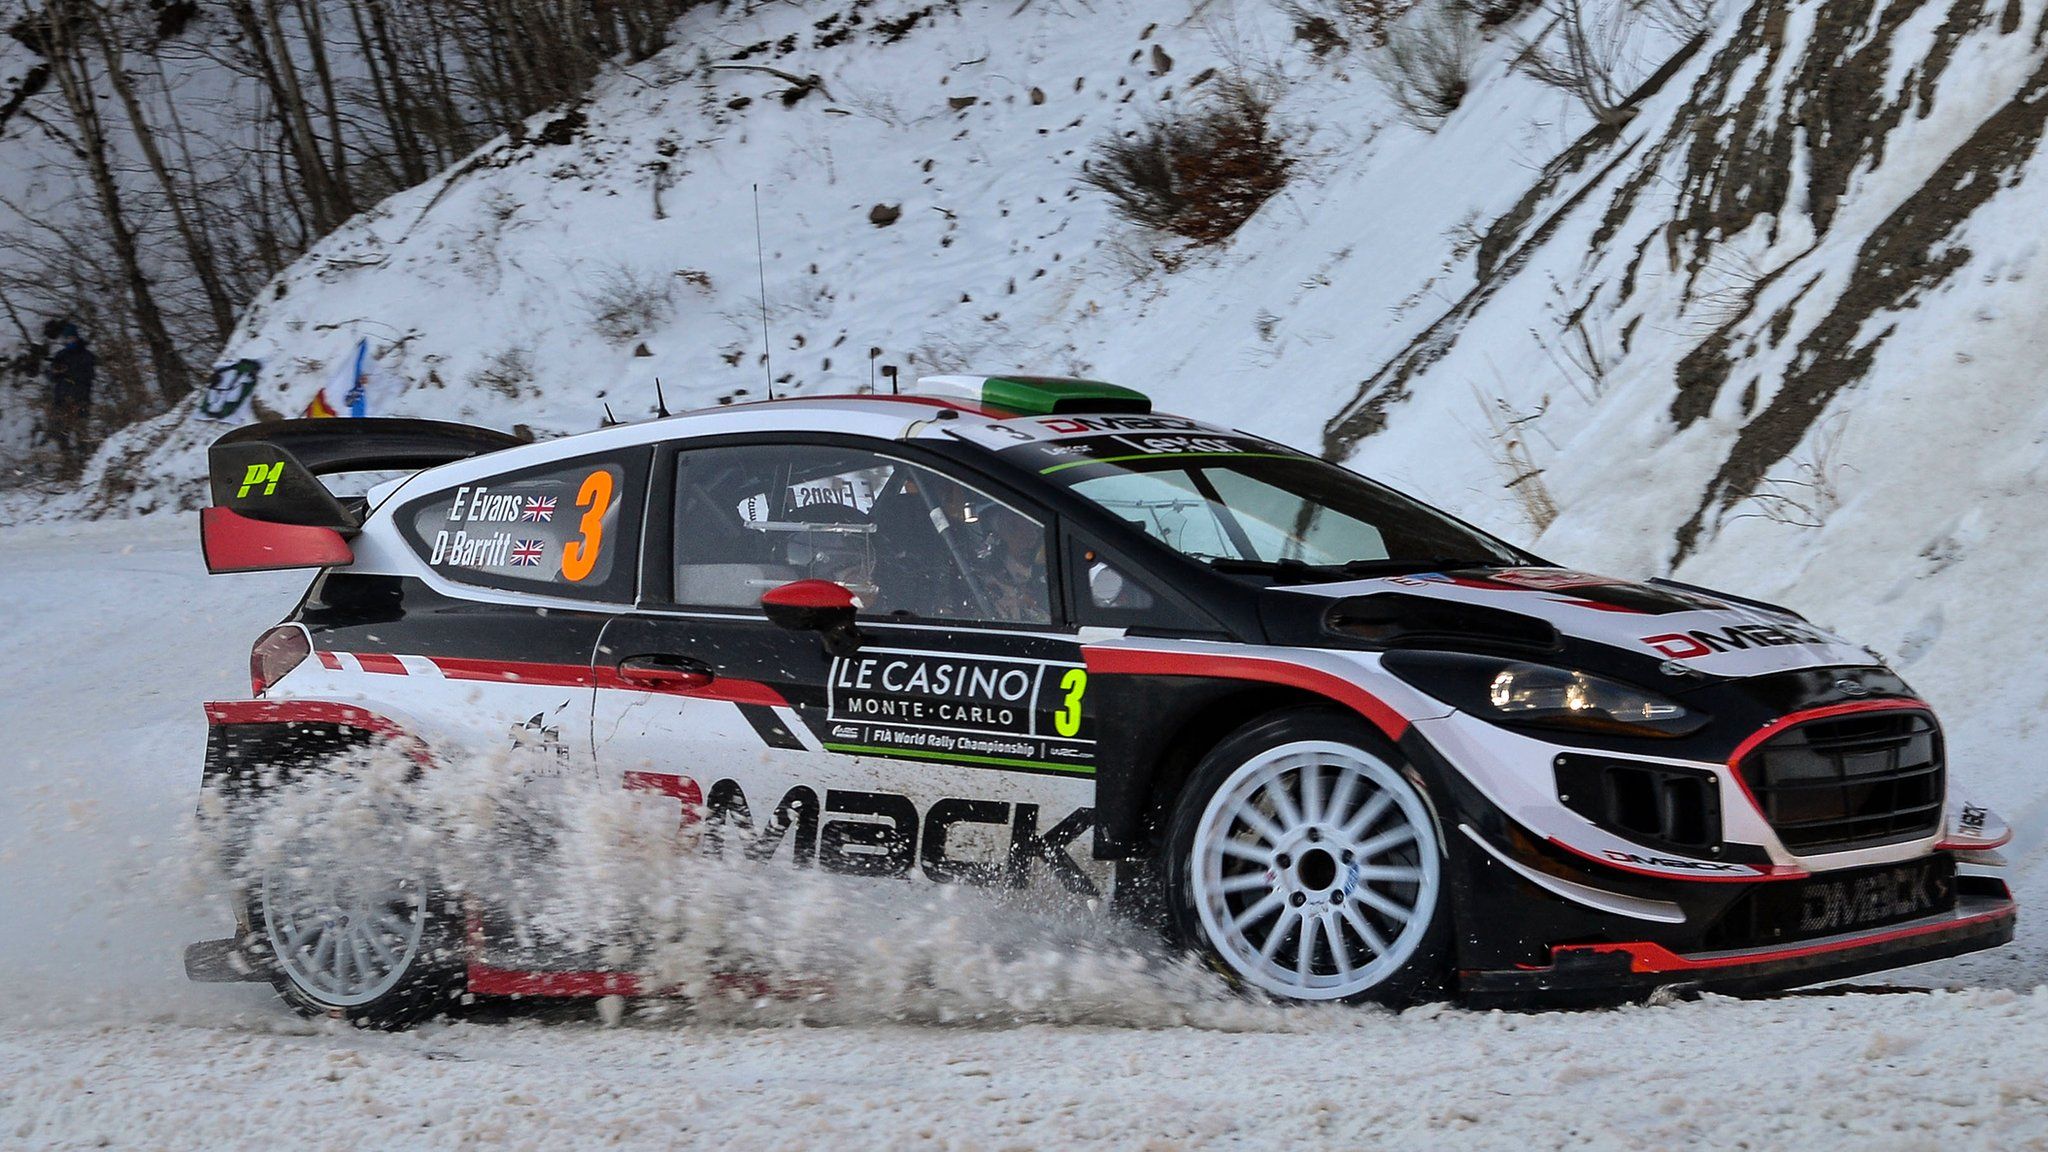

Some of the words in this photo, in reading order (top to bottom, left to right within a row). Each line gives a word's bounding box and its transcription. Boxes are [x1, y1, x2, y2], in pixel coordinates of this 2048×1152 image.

[1110, 434, 1244, 453] Lexar
[236, 461, 285, 498] P1
[450, 486, 470, 522] E
[467, 486, 523, 522] Evans
[560, 470, 613, 582] 3
[430, 530, 449, 565] D
[448, 530, 512, 566] Barritt
[1639, 624, 1826, 659] DMAC
[838, 658, 877, 689] LE
[881, 660, 1029, 701] CASINO
[1054, 668, 1088, 737] 3
[873, 729, 892, 742] FIA
[894, 731, 926, 745] World
[927, 734, 956, 750] Rally
[957, 737, 1035, 757] Championship
[1602, 850, 1747, 873] DMACK
